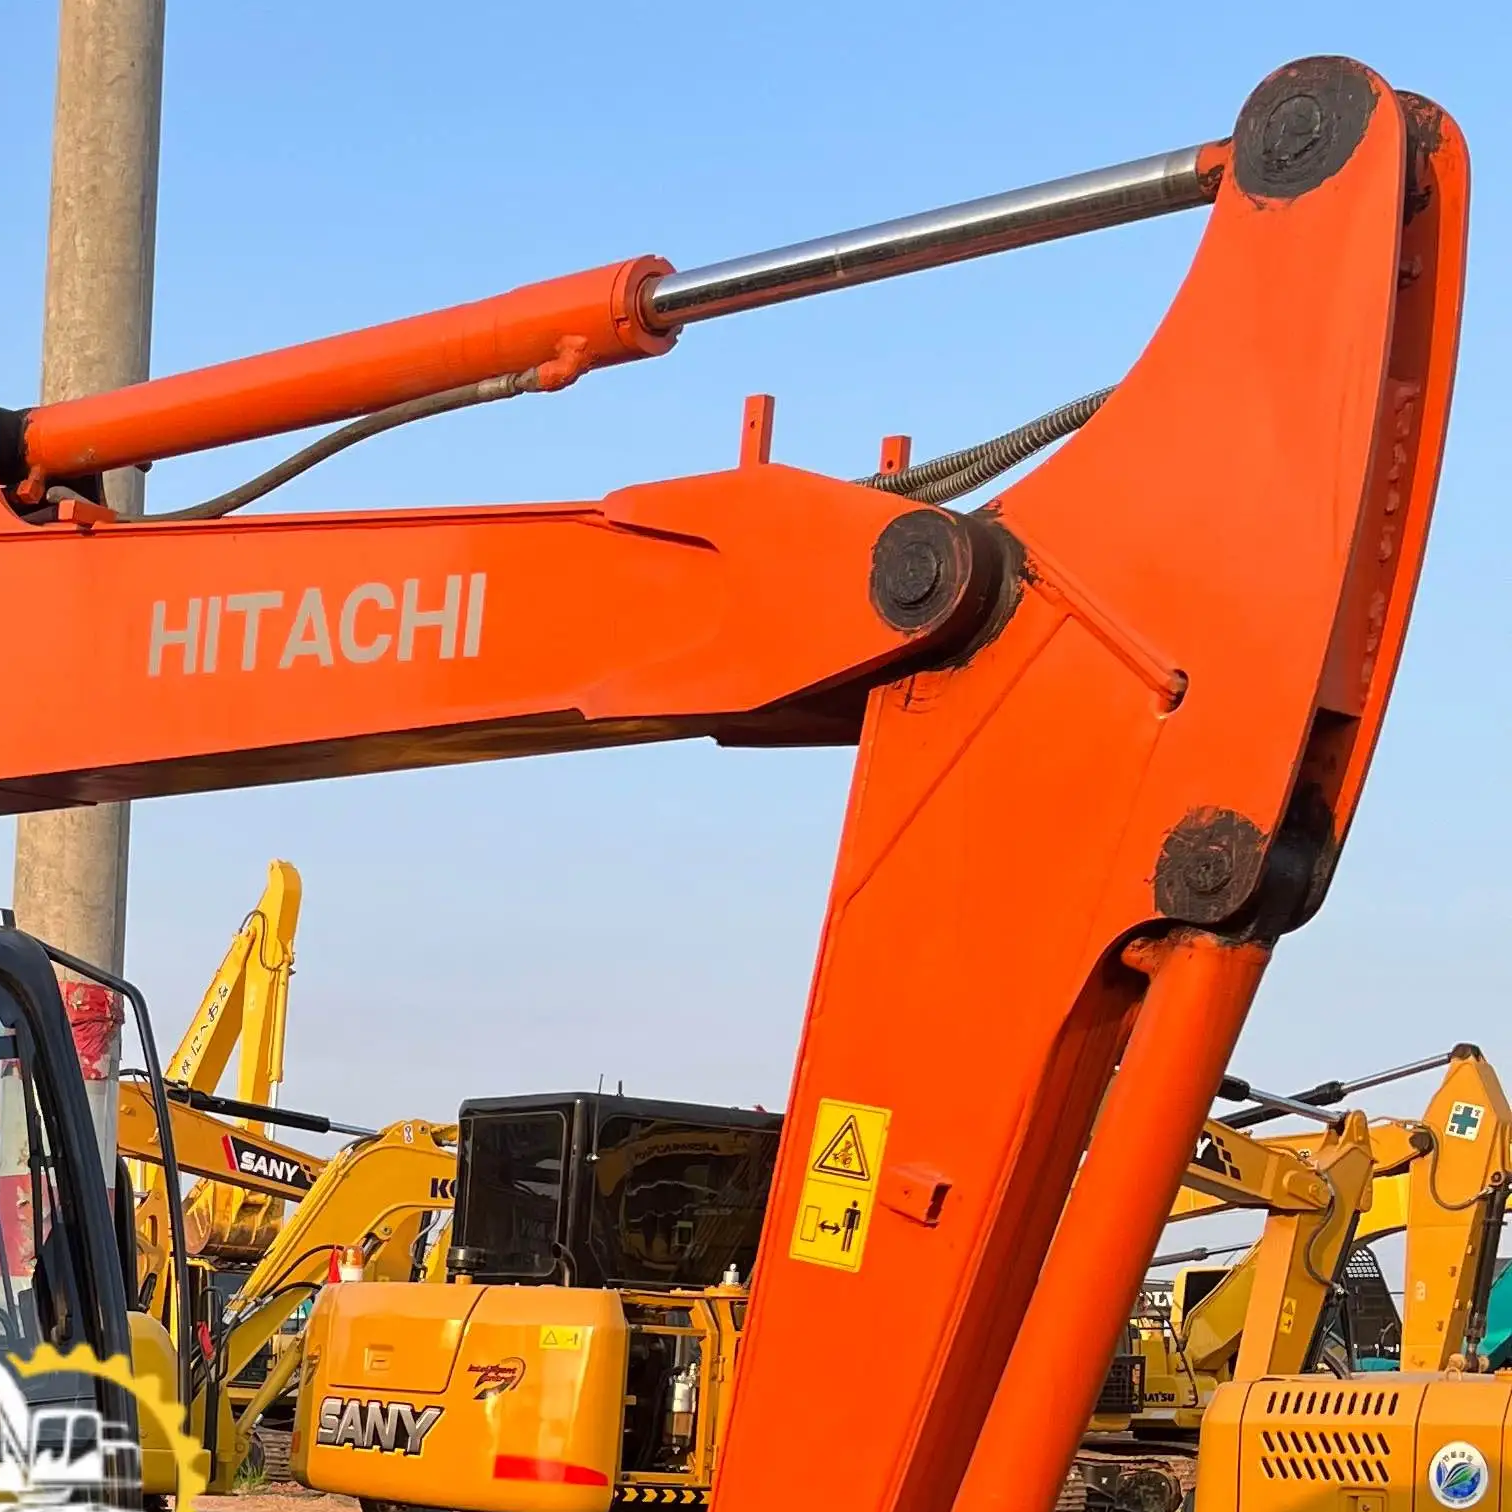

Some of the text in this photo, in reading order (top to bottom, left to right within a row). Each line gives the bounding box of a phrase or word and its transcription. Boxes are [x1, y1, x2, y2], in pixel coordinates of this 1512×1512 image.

[148, 573, 487, 678] HITACHI
[240, 1150, 299, 1182] SANY
[317, 1396, 445, 1456] SANY
